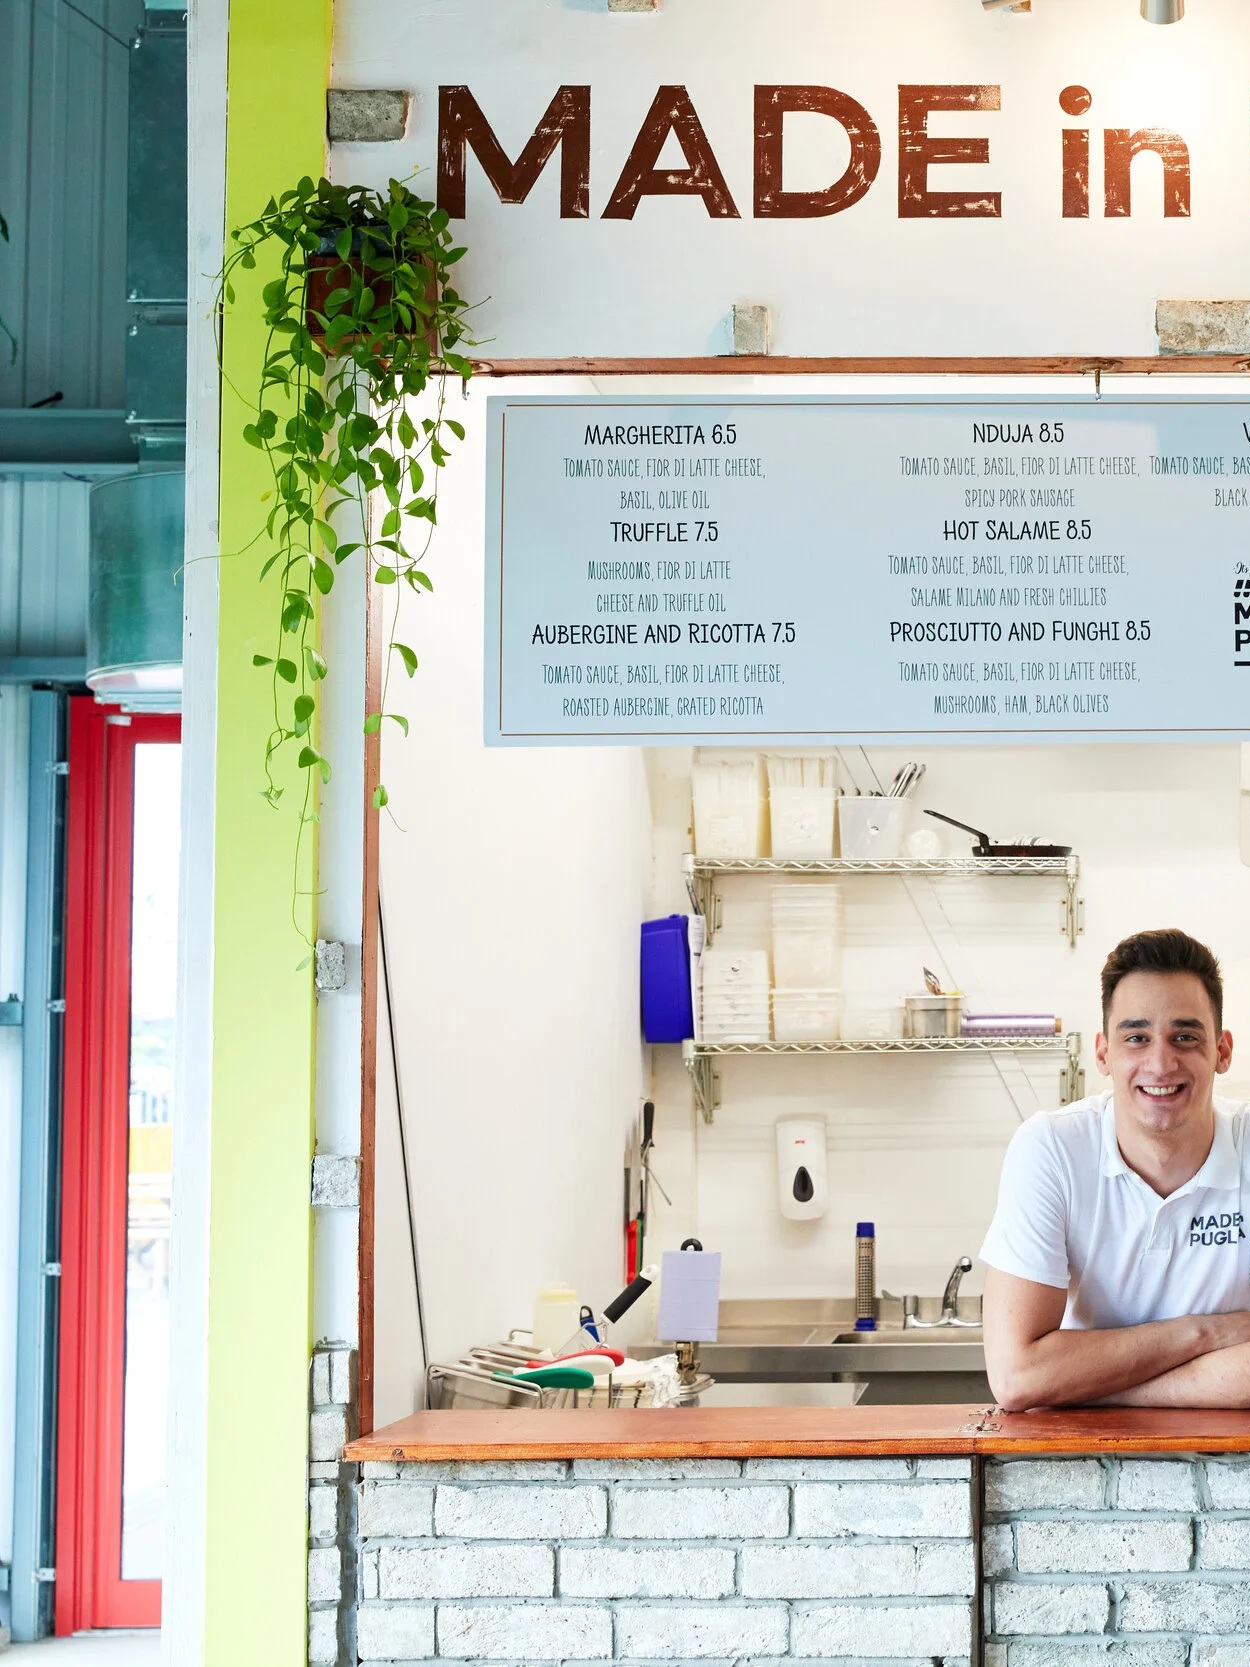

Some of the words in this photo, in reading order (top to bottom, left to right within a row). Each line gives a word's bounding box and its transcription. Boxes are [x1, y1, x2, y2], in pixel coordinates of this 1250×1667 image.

[436, 84, 1002, 219] MADE
[1058, 84, 1192, 219] in
[584, 424, 706, 446] MARGHERITA
[710, 423, 737, 445] 6.5
[973, 422, 1034, 444] NDUJA
[1038, 422, 1065, 444] 8.5
[563, 457, 604, 478] TOMATO
[607, 458, 644, 480] SAUCE,
[646, 458, 671, 478] FIOR
[674, 458, 686, 478] DI
[689, 457, 721, 478] LATTE
[724, 457, 766, 479] CHEESE,
[899, 455, 940, 477] TOMATO
[941, 456, 980, 478] SAUCE,
[983, 456, 1019, 480] BASIL,
[1021, 456, 1047, 476] FIOR
[1048, 456, 1060, 476] DI
[1064, 456, 1096, 476] LATTE
[1099, 456, 1140, 478] CHEESE,
[1148, 455, 1189, 476] TOMATO
[1192, 456, 1229, 478] SAUCE,
[619, 490, 655, 512] BASIL,
[658, 489, 689, 510] OLIVE
[691, 489, 710, 510] OIL
[964, 488, 996, 508] SPICY
[997, 487, 1027, 508] PORK
[1029, 488, 1076, 508] SAUSAGE
[1214, 487, 1249, 508] BLACK
[609, 521, 689, 543] TRUFFLE
[694, 520, 719, 543] 7.5
[942, 519, 980, 541] HOT
[985, 519, 1061, 541] SALAME
[1066, 519, 1092, 541] 8.5
[587, 560, 654, 583] MUSHROOMS,
[656, 560, 681, 580] FIOR
[684, 560, 696, 580] DI
[700, 560, 732, 580] LATTE
[887, 554, 929, 576] TOMATO
[929, 555, 969, 577] SAUCE,
[970, 555, 1008, 577] BASIL,
[1009, 552, 1035, 575] FIOR
[1037, 555, 1049, 575] DI
[1052, 554, 1085, 575] LATTE
[1088, 554, 1129, 576] CHEESE,
[596, 592, 635, 613] CHEESE
[637, 593, 659, 613] AND
[662, 592, 707, 613] TRUFFLE
[708, 592, 727, 614] OIL
[910, 586, 953, 608] SALAME
[956, 584, 997, 607] MILANO
[999, 587, 1021, 608] AND
[1023, 587, 1055, 607] FRESH
[1059, 586, 1107, 607] CHILLIES
[531, 623, 639, 645] AUBERGINE
[643, 623, 682, 645] AND
[687, 622, 766, 644] RICOTTA
[771, 621, 796, 644] 7.5
[889, 621, 1002, 643] PROSCIUTTO
[1007, 621, 1046, 642] AND
[1052, 620, 1120, 642] FUNGHI
[1125, 619, 1151, 641] 8.5
[541, 663, 583, 685] TOMATO
[586, 664, 623, 687] SAUCE,
[625, 664, 662, 687] BASIL,
[664, 664, 689, 684] FIOR
[692, 664, 704, 684] DI
[708, 663, 740, 684] LATTE
[743, 663, 785, 685] CHEESE,
[897, 661, 939, 682] TOMATO
[942, 662, 979, 684] SAUCE,
[983, 662, 1018, 684] BASIL,
[1020, 661, 1045, 682] FIOR
[1048, 661, 1060, 681] DI
[1064, 659, 1096, 681] LATTE
[1099, 661, 1141, 683] CHEESE,
[562, 697, 610, 717] ROASTED
[613, 696, 674, 719] AUBERGINE,
[676, 696, 717, 716] GRATED
[719, 696, 764, 716] RICOTTA
[933, 694, 1000, 716] MUSHROOMS,
[1004, 694, 1032, 716] HAM,
[1035, 693, 1070, 714] BLACK
[1072, 693, 1109, 714] OLIVES
